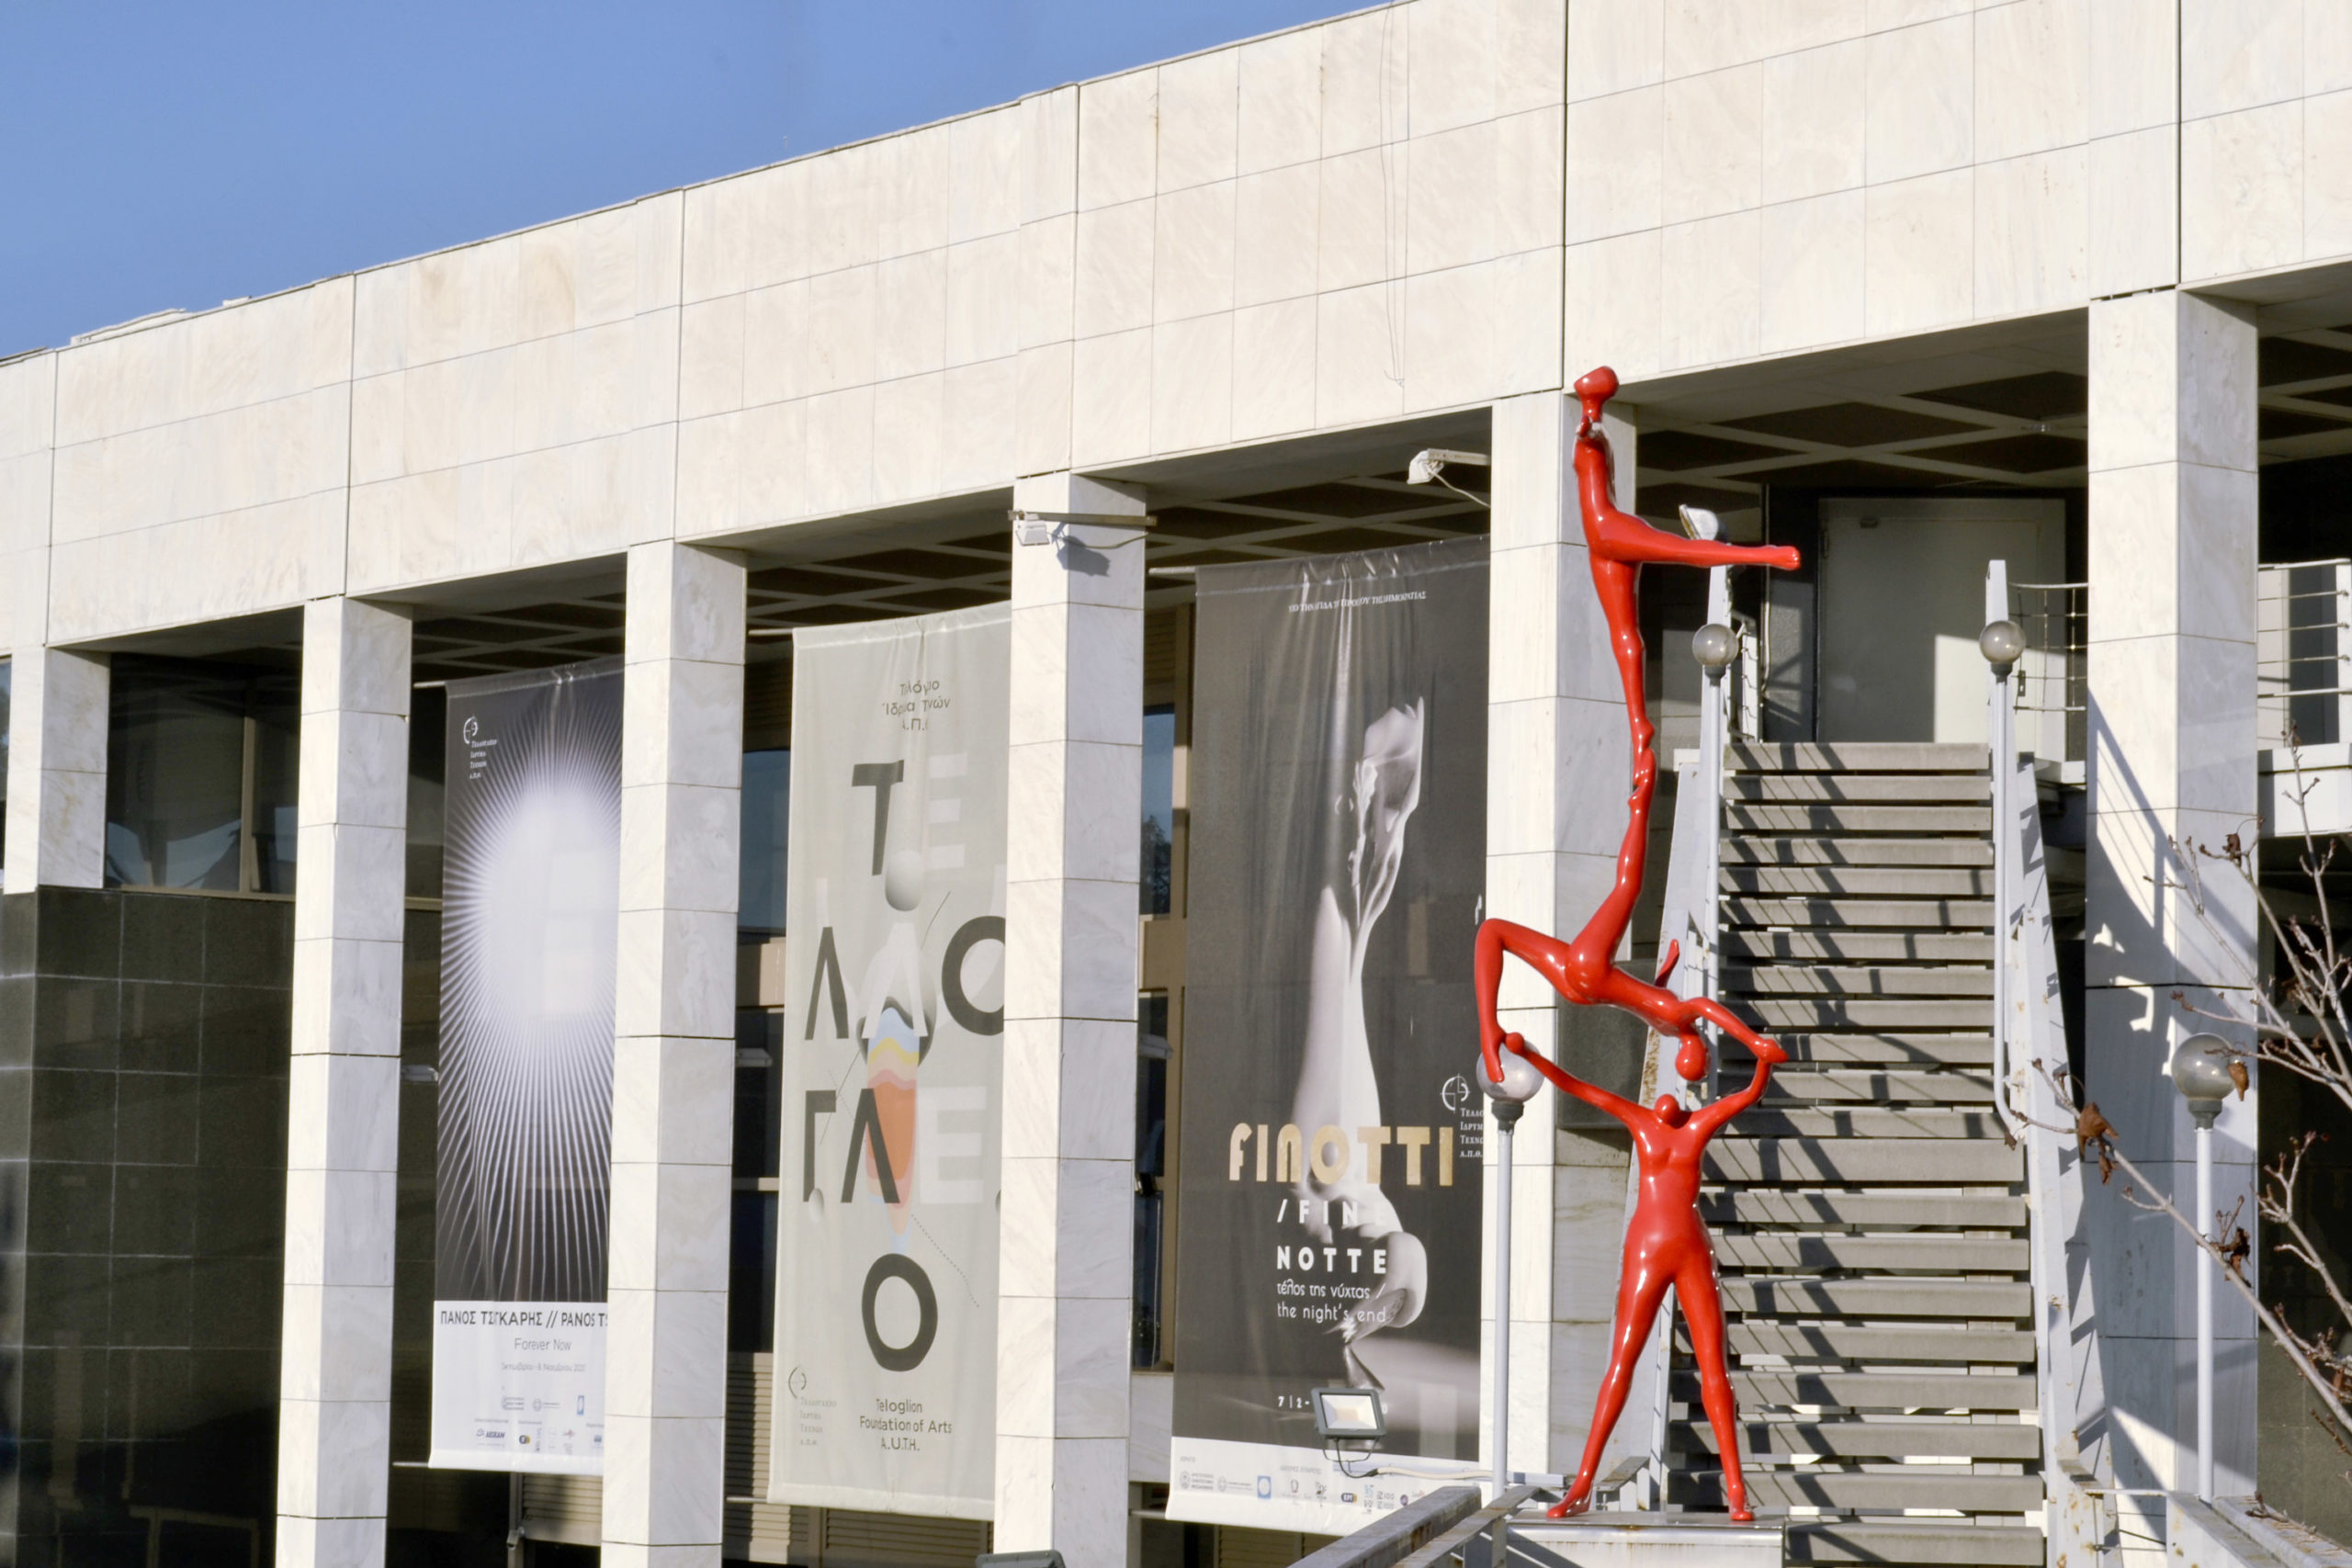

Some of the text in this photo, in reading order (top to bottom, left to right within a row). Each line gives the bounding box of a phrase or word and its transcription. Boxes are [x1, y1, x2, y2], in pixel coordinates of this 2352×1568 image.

[1276, 1245, 1387, 1275] NOTTE
[1276, 1278, 1306, 1296] τέλος
[1309, 1284, 1327, 1297] της
[1330, 1282, 1371, 1300] νύχτας
[440, 1311, 476, 1325] ΠΑΝΟΣ
[560, 1312, 596, 1328] PANOS
[1277, 1301, 1296, 1318] the
[1356, 1306, 1386, 1324] end
[553, 1338, 572, 1351] Now
[912, 1419, 924, 1433] of
[928, 1420, 953, 1434] Arts
